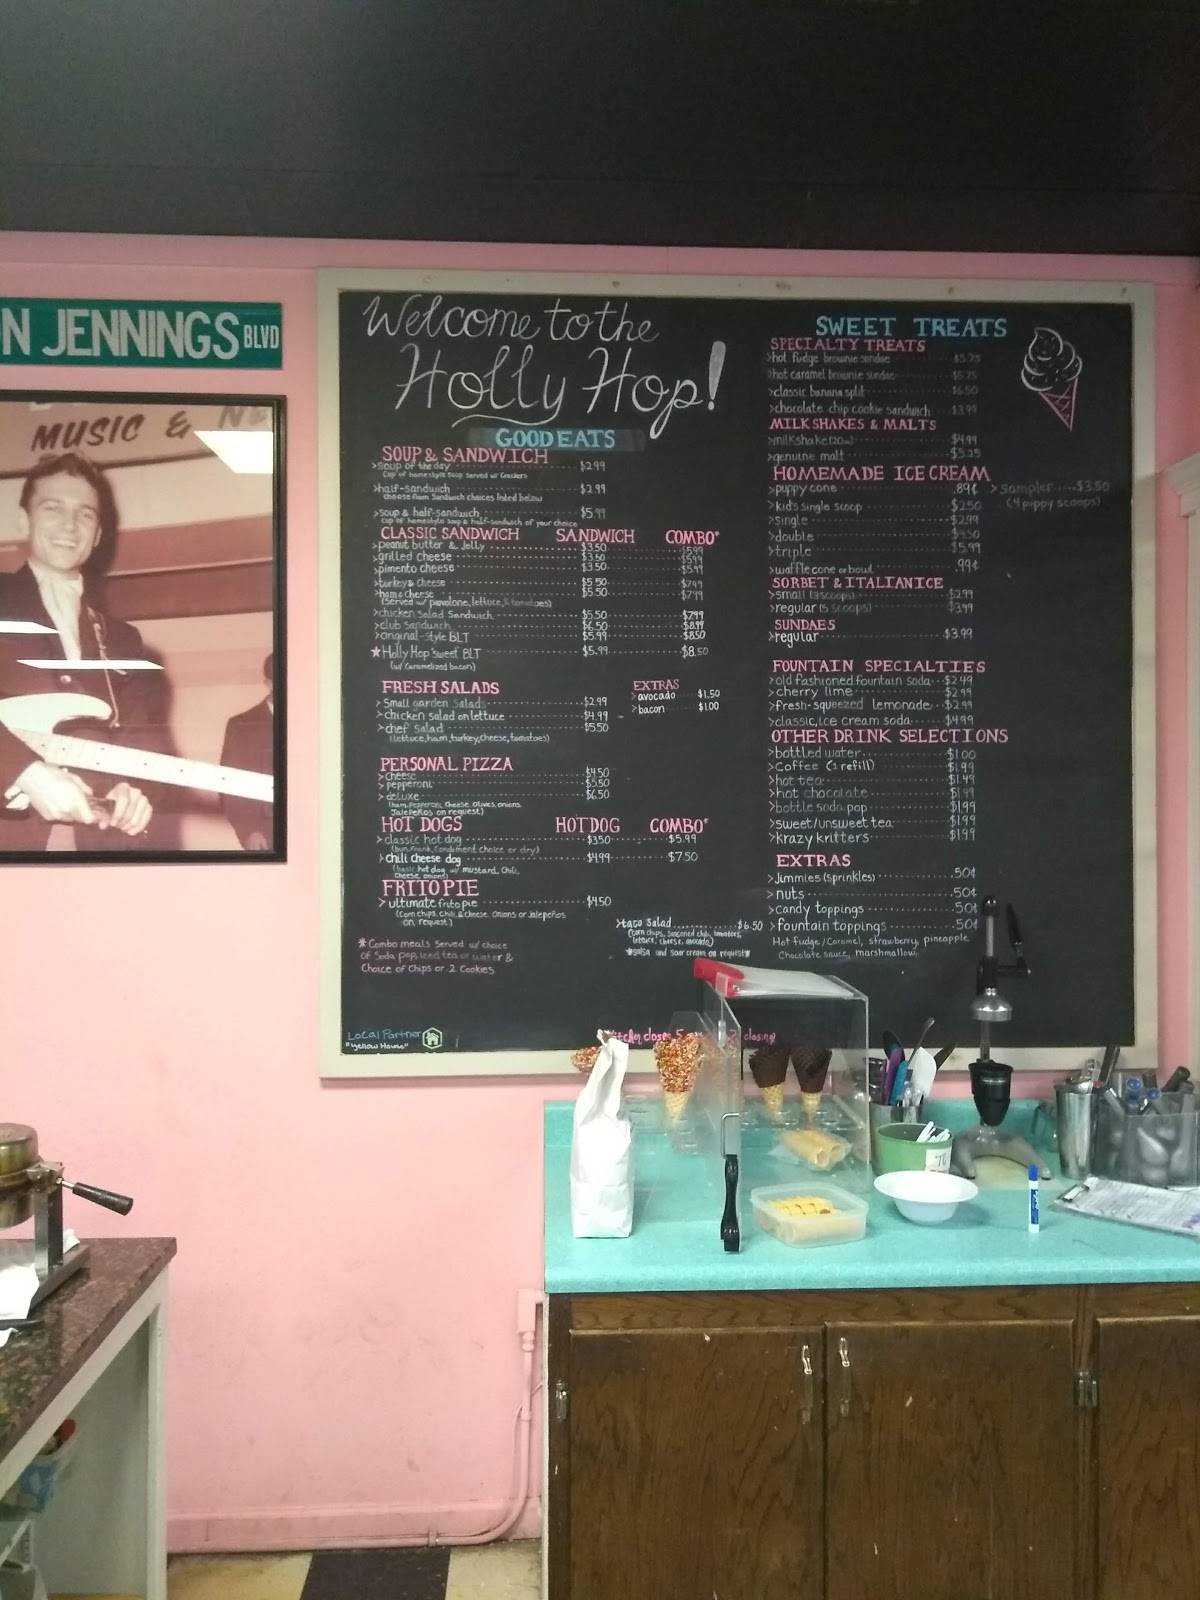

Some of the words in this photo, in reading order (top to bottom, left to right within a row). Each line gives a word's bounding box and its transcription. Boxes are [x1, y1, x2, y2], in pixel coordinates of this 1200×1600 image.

[363, 294, 541, 340] Welcome
[544, 298, 594, 341] to
[594, 301, 660, 342] the
[42, 308, 240, 360] JENNINGS
[243, 324, 280, 350] BLVD
[816, 315, 896, 336] SWEET
[913, 317, 1008, 338] TREATS
[770, 337, 860, 352] SPECIALTY
[864, 339, 927, 352] TREATS
[792, 351, 819, 367] fudge
[790, 368, 827, 381] caramel
[395, 343, 566, 426] Holly
[582, 341, 727, 439] Hop!
[773, 384, 807, 398] classic
[809, 385, 843, 398] banana
[774, 400, 824, 414] chocolate
[828, 401, 850, 417] chip
[851, 402, 884, 414] cookie
[886, 403, 931, 417] sandwich
[31, 413, 145, 451] MUSIC
[166, 411, 193, 440] &
[870, 419, 879, 431] &
[883, 418, 937, 431] MALTS
[495, 428, 553, 449] GOOD
[556, 430, 617, 449] EATS
[382, 446, 422, 462] SOUP
[424, 447, 438, 462] &
[443, 448, 548, 463] SANDWICH
[772, 451, 816, 464] genuine
[819, 449, 846, 462] malt
[773, 465, 885, 481] HOMEMADE
[893, 465, 926, 481] ICE
[928, 465, 992, 482] CREAM
[580, 483, 606, 495] $2.99
[775, 484, 808, 498] puppy
[809, 484, 839, 494] cone
[834, 503, 864, 516] scoop
[774, 514, 809, 529] single
[381, 526, 438, 540] CLASSIC
[441, 527, 520, 540] SANDWICH
[556, 528, 636, 543] SANDWICH
[775, 529, 815, 543] double
[774, 543, 813, 560] triple
[378, 563, 418, 577] pimento
[774, 562, 811, 576] waffle
[811, 564, 837, 575] cone
[848, 563, 875, 576] bowl
[772, 577, 830, 589] SORBET
[833, 577, 843, 589] &
[775, 590, 808, 601] small
[774, 603, 818, 617] regular
[774, 619, 837, 631] SUNDAES
[774, 631, 820, 648] regular
[944, 627, 973, 640] $3.99
[462, 648, 482, 660] BLT
[582, 645, 609, 658] $5.99
[681, 644, 710, 660] $8.50
[772, 659, 854, 673] FOUNTAIN
[864, 660, 987, 674] SPECIALTIES
[382, 680, 438, 694] FRESH
[440, 680, 500, 695] SALADS
[632, 678, 681, 691] EXTRAS
[775, 674, 793, 686] old
[794, 673, 854, 687] fashioned
[855, 674, 903, 687] fountain
[906, 675, 932, 686] soda
[637, 690, 676, 701] avocado
[697, 689, 721, 700] $1.50
[775, 685, 819, 700] cherry
[824, 686, 854, 697] lime
[583, 696, 608, 708] $2.99
[638, 703, 665, 715] bacon
[775, 697, 865, 714] fresh-squeezed
[872, 697, 932, 712] lemonade
[583, 710, 608, 722] $4.99
[841, 715, 881, 727] cream
[883, 714, 912, 727] soda
[771, 729, 829, 744] OTHER
[834, 729, 892, 744] DRINK
[899, 729, 1010, 744] SELECTIONS
[775, 746, 823, 760] bottled
[825, 747, 863, 760] water
[380, 756, 459, 772] PERSONAL
[462, 756, 514, 772] PIZZA
[775, 774, 795, 787] hot
[797, 775, 824, 786] tea
[386, 792, 420, 802] deluxe
[776, 787, 799, 800] hot
[803, 787, 870, 799] chocolate
[775, 801, 814, 814] bottle
[847, 803, 869, 816] pop
[950, 800, 977, 813] $1.99
[381, 816, 415, 833] HOT
[419, 816, 463, 833] DOGS
[555, 816, 589, 833] HOT
[589, 817, 621, 834] DOG
[775, 817, 870, 830] sweet/unsweet
[871, 816, 895, 829] tea
[444, 834, 463, 847] dog
[775, 832, 814, 850] krazy
[816, 831, 871, 844] kritters
[385, 852, 409, 864] chili
[445, 853, 463, 867] dog
[775, 853, 852, 868] EXTRAS
[823, 870, 877, 886] (sprinkles)
[382, 879, 441, 896] FRITO
[442, 879, 480, 896] PIE
[776, 887, 806, 901] nuts
[388, 896, 437, 909] ultimate
[461, 897, 479, 911] pie
[775, 901, 811, 919] candy
[814, 900, 865, 919] toppings
[737, 919, 764, 931] $6.50
[777, 917, 831, 932] fountain
[832, 919, 888, 936] toppings
[923, 933, 971, 947] pineapple
[448, 963, 456, 973] 2
